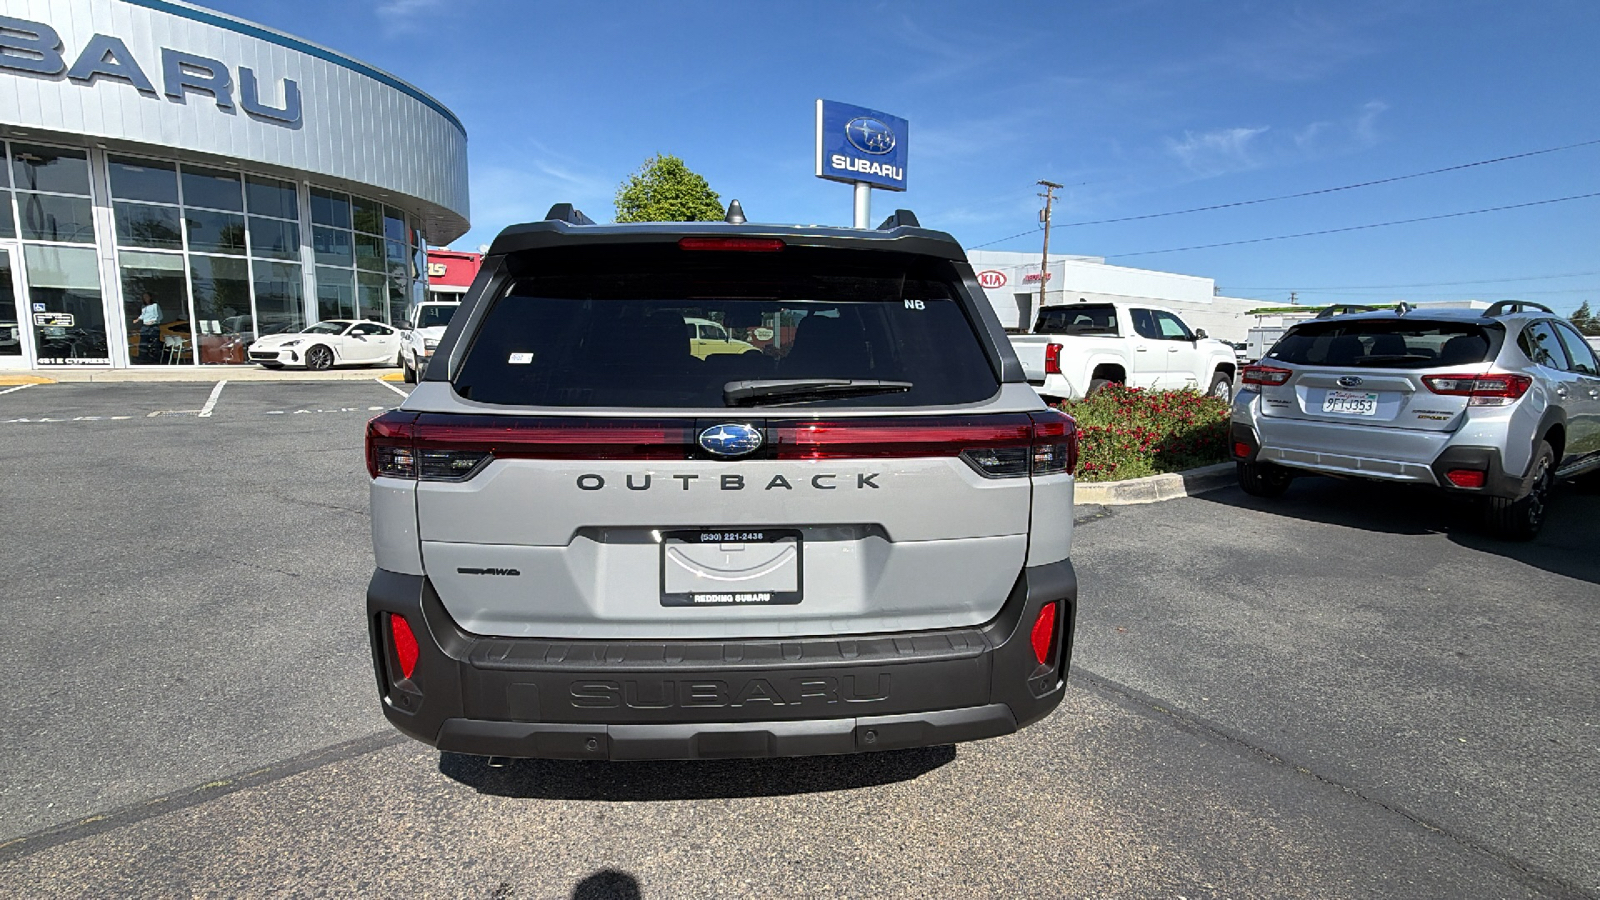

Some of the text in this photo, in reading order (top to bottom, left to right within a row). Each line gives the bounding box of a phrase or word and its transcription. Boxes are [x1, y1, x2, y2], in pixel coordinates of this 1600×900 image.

[832, 154, 902, 180] SUBARU
[980, 274, 1002, 286] KIA
[904, 298, 926, 310] NB
[1326, 398, 1373, 411] 9FTJ353
[576, 473, 880, 490] OUTBACK
[700, 533, 722, 542] (530)
[694, 593, 771, 603] REDDING SUBARU
[569, 673, 892, 709] SUBARU
